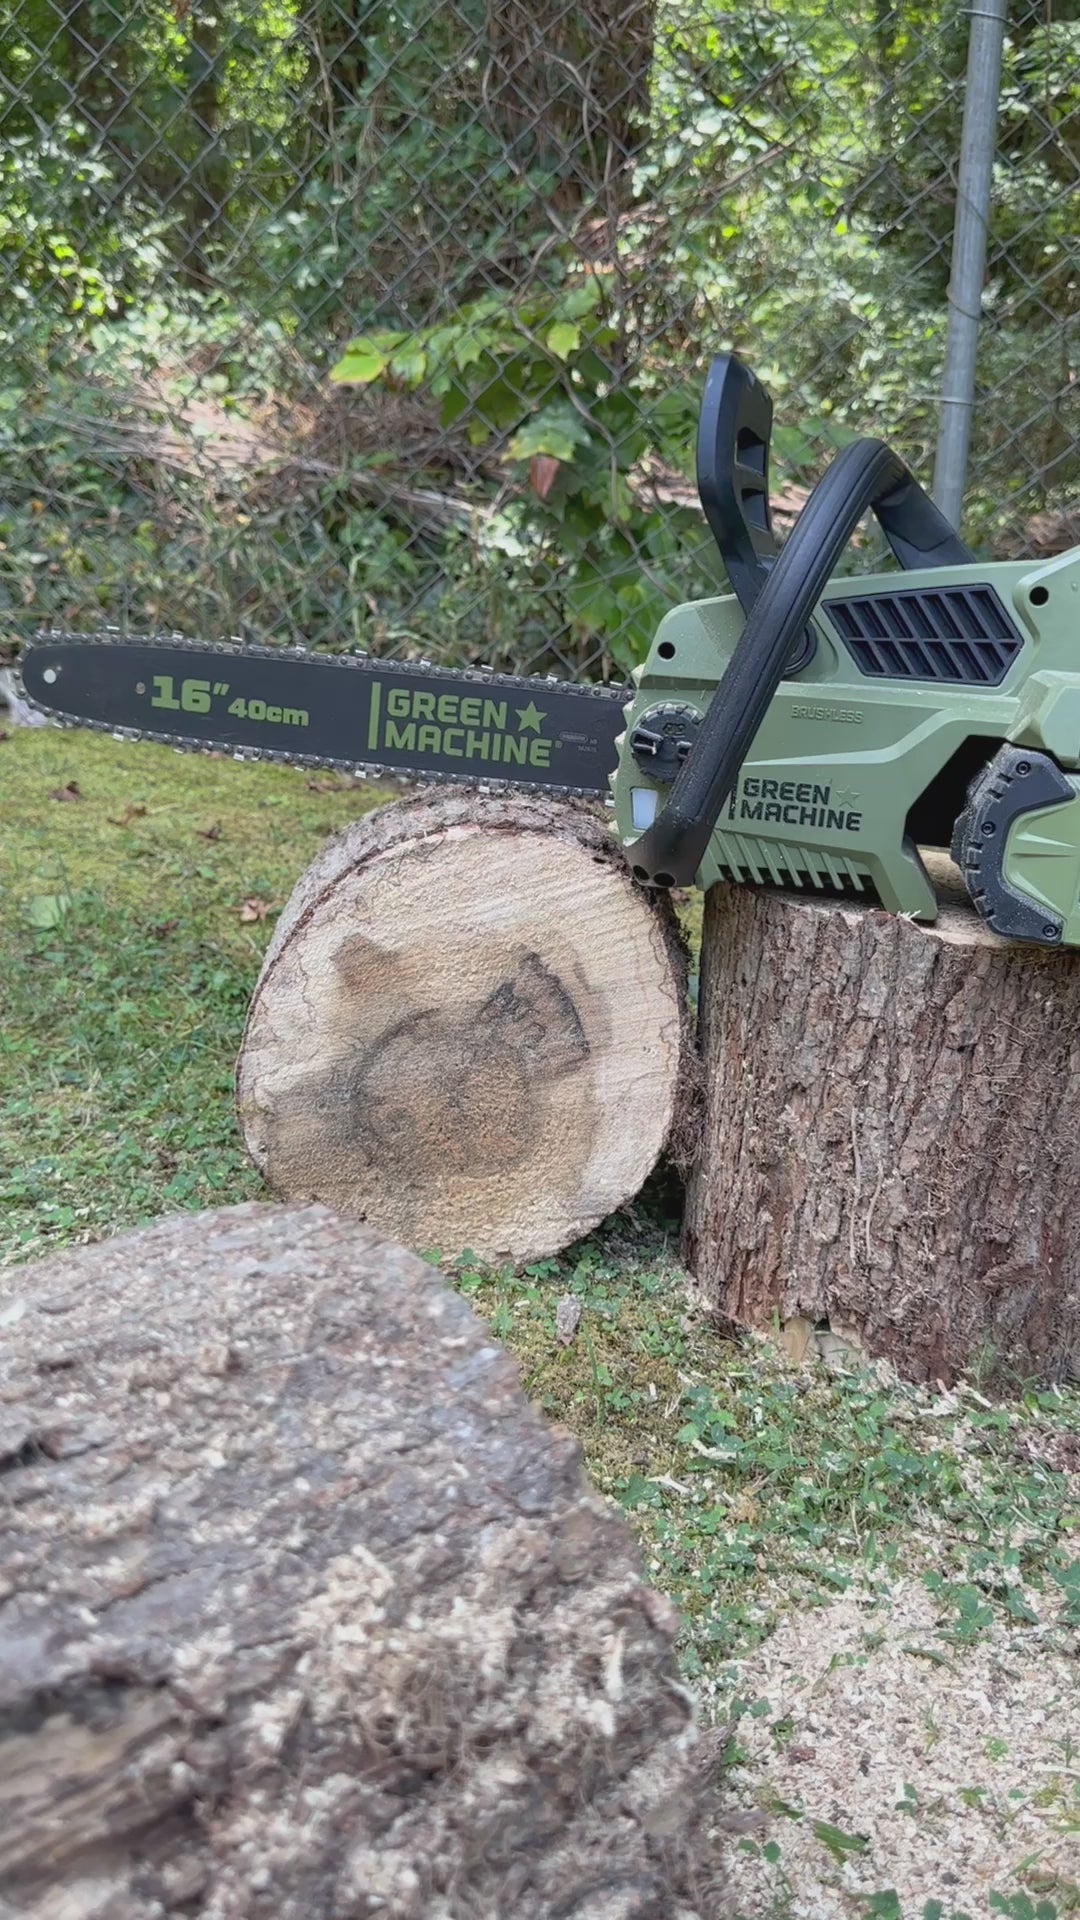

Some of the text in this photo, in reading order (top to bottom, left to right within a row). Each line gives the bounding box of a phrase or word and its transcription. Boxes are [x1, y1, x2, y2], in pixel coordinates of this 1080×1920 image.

[151, 676, 309, 727] 16" 40cm
[387, 688, 508, 730] GREEN
[791, 704, 864, 724] BRUSHLESS
[384, 719, 552, 768] MACHINE
[743, 777, 831, 806] GREEN
[740, 799, 862, 832] MACHINE
